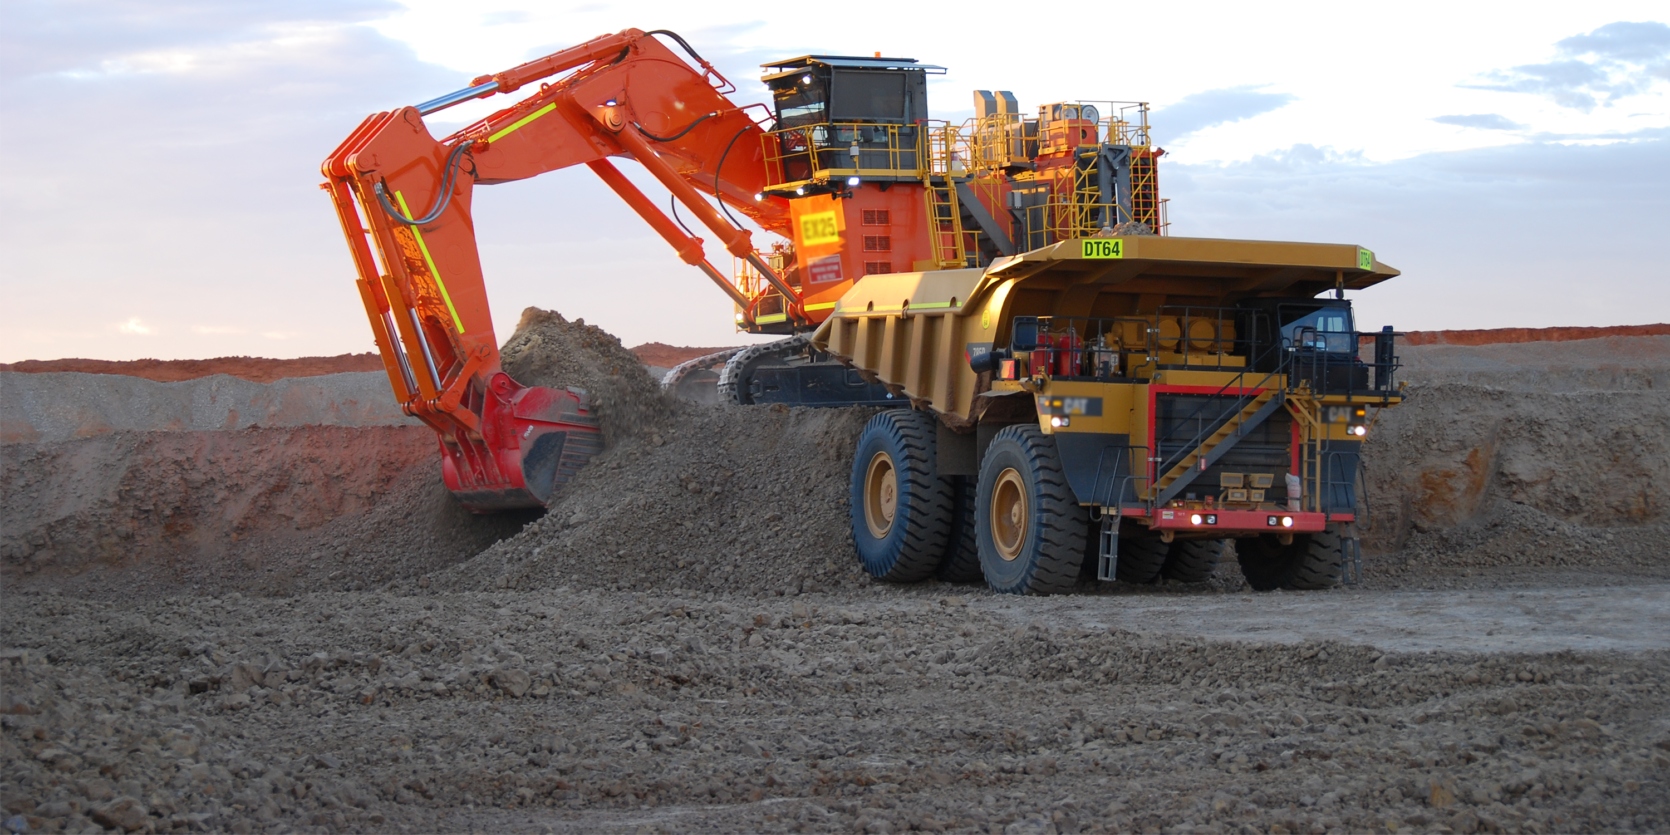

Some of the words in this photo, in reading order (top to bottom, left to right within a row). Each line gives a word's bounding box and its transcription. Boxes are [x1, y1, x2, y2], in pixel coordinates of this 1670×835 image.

[803, 217, 836, 239] EX25
[1084, 241, 1120, 257] DT64
[1063, 398, 1088, 414] CAT
[1329, 406, 1352, 422] CAT
